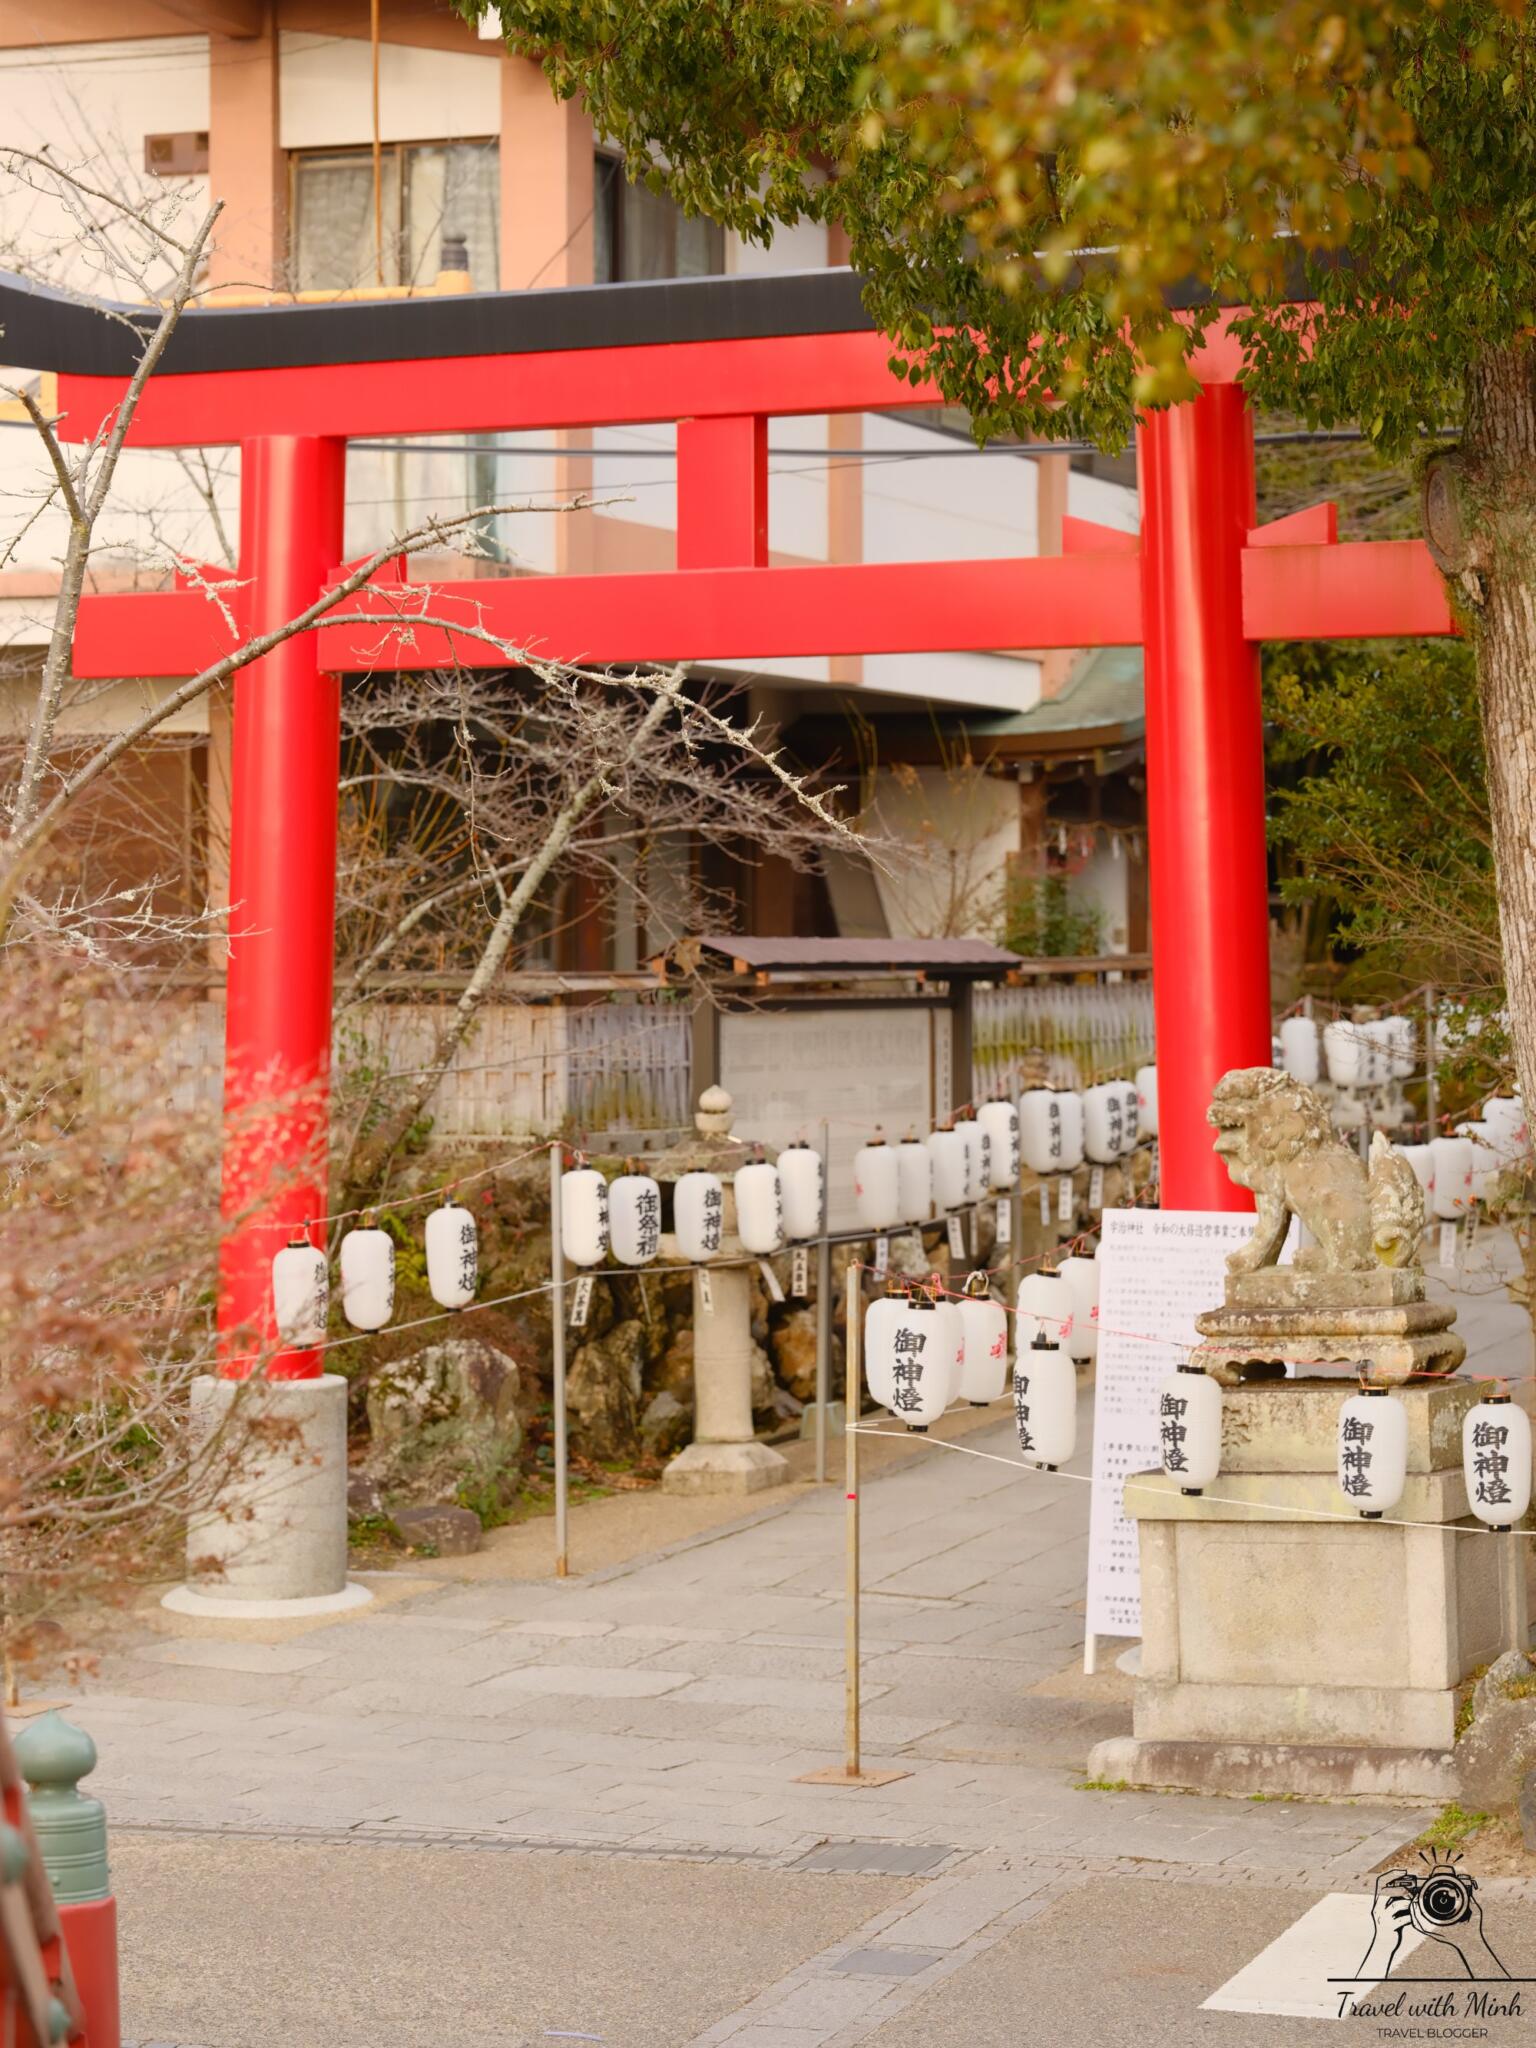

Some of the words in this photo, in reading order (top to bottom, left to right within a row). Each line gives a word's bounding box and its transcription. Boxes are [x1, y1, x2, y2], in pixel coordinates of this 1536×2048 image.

[892, 1327, 927, 1413] 御神燈
[1160, 1393, 1188, 1473] 御神燈
[1341, 1416, 1375, 1497] 御神燈
[1471, 1421, 1512, 1505] 御神燈
